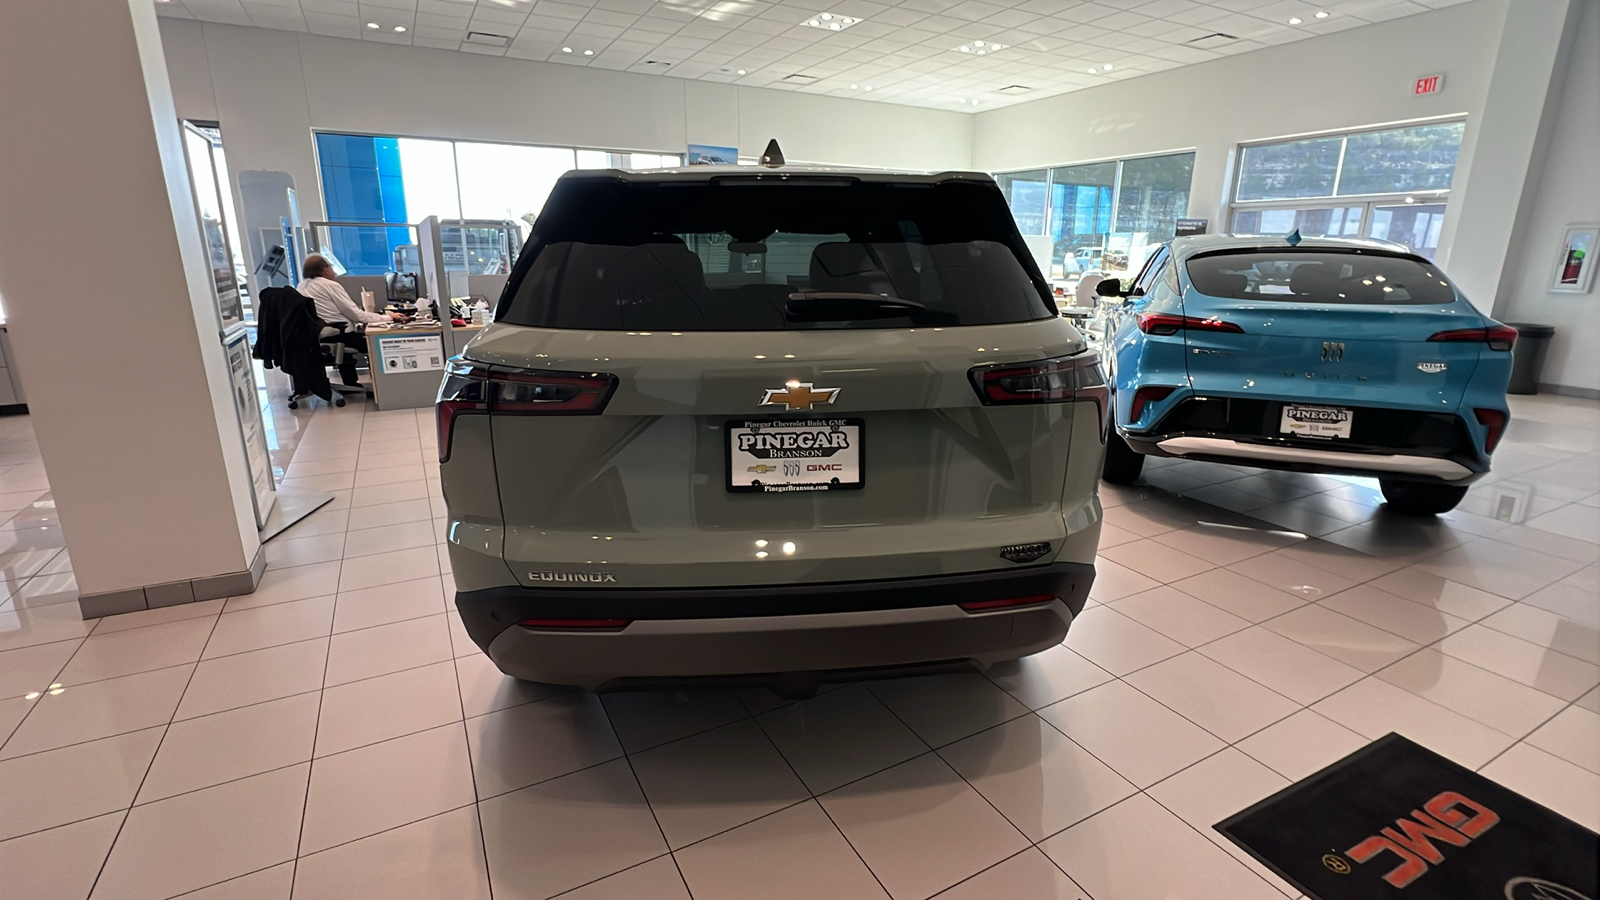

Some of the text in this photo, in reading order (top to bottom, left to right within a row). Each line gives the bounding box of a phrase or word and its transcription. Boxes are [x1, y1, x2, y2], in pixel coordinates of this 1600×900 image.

[1414, 75, 1440, 95] EXIT
[1288, 409, 1348, 421] PINEGAR
[744, 421, 771, 429] Pinegar
[773, 420, 806, 428] Chevrolet
[829, 419, 847, 427] GMC
[739, 432, 848, 450] PINEGAR
[769, 448, 823, 459] BRANSON
[806, 463, 843, 472] GMC
[764, 485, 829, 493] PinegarBranson.com
[528, 570, 617, 583] EQUINOX
[1344, 791, 1501, 889] GMC
